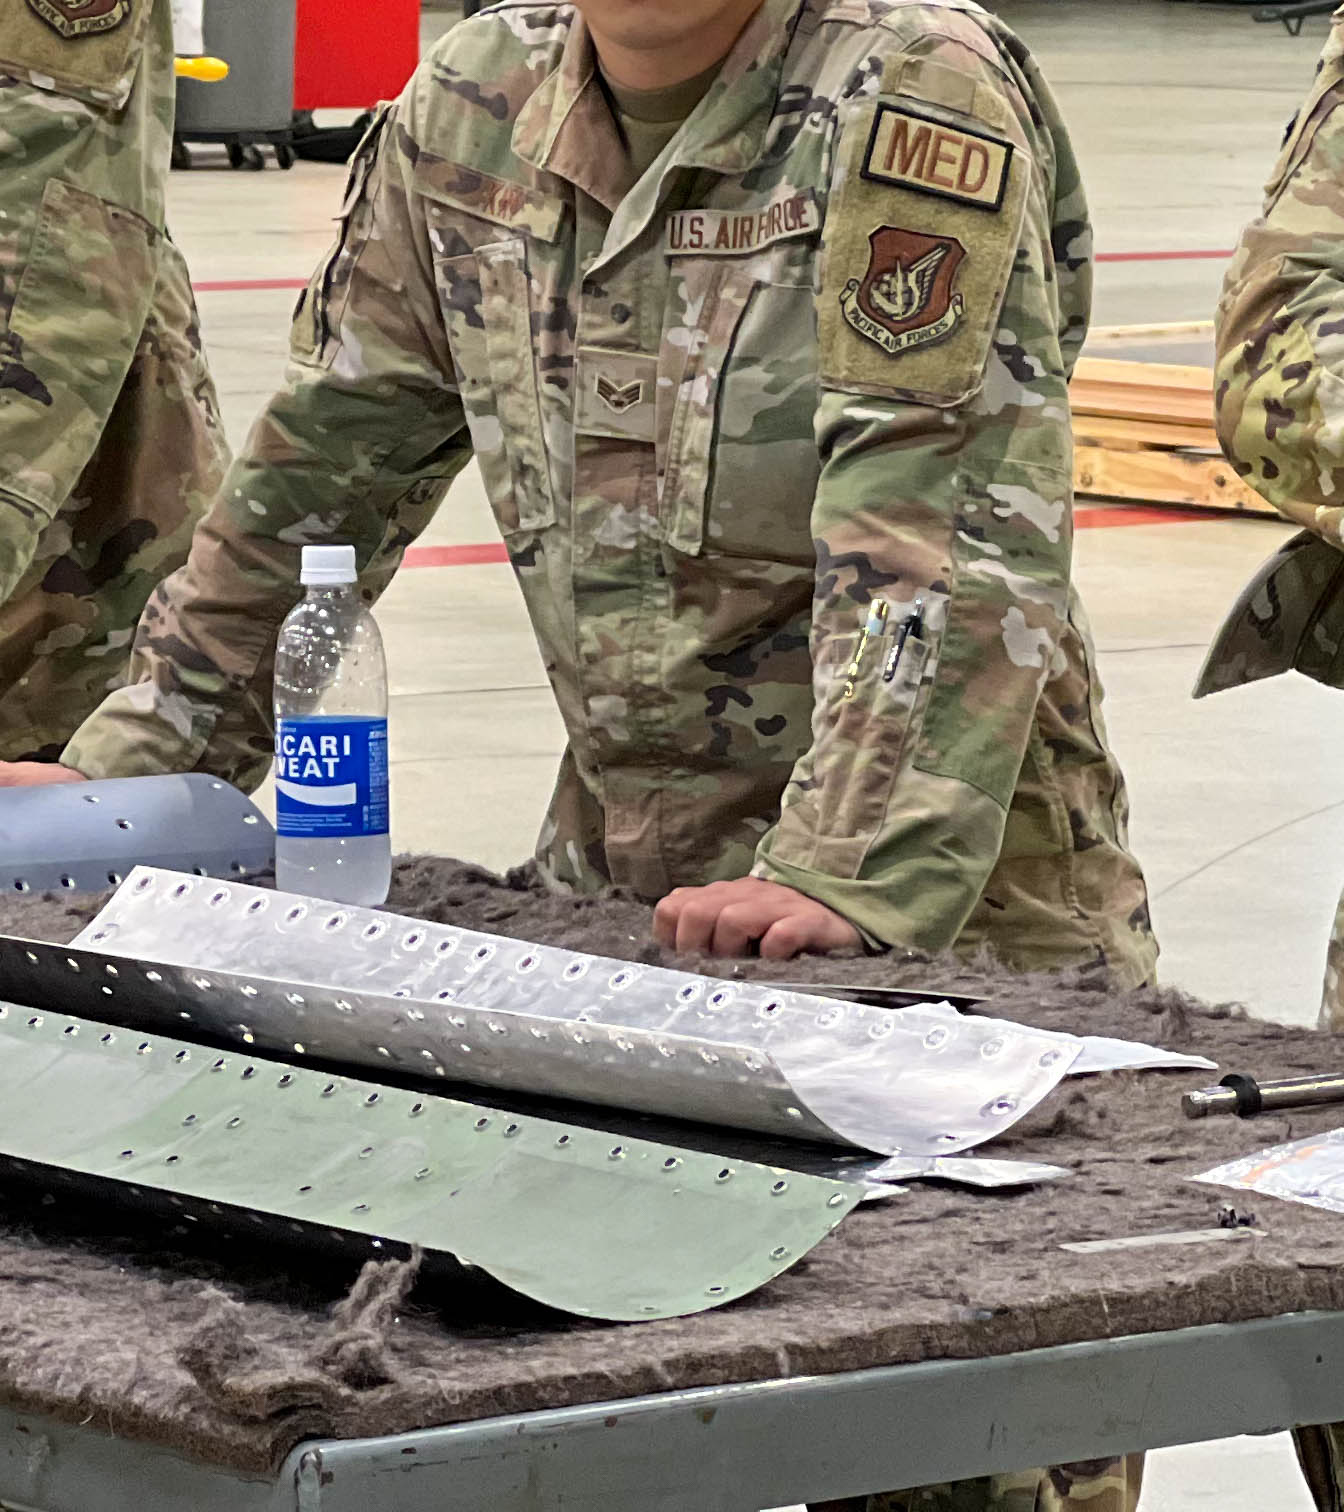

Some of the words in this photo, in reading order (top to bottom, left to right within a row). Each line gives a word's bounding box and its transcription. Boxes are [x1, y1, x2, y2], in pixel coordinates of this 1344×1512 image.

[883, 119, 989, 194] MED
[670, 214, 709, 249] U.S.
[713, 215, 753, 250] AIR
[847, 307, 884, 341] PACIFIC
[883, 332, 902, 349] AIR
[906, 320, 949, 345] FORCES
